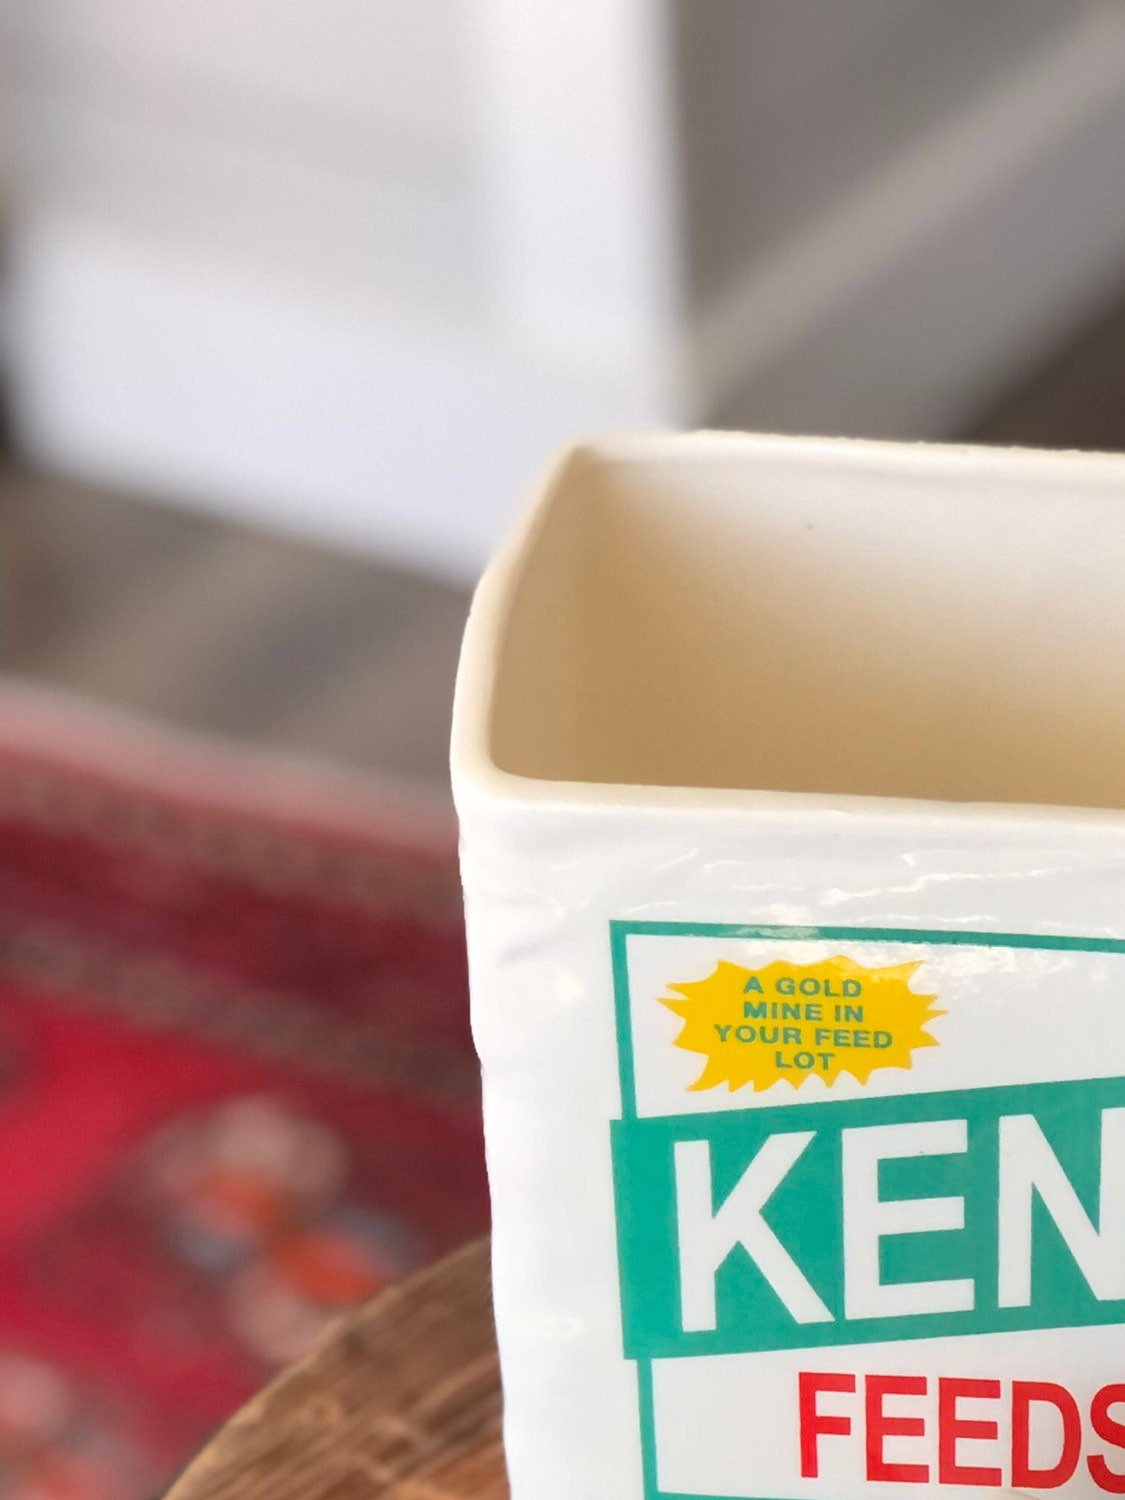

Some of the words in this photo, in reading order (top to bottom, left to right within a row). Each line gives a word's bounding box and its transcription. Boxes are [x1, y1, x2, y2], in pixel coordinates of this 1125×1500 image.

[743, 976, 763, 995] A
[775, 977, 863, 998] GOLD
[743, 1001, 823, 1021] MINE
[834, 1004, 864, 1023] IN
[714, 1023, 802, 1045] YOUR
[815, 1028, 892, 1049] FEED
[775, 1050, 835, 1070] LOT
